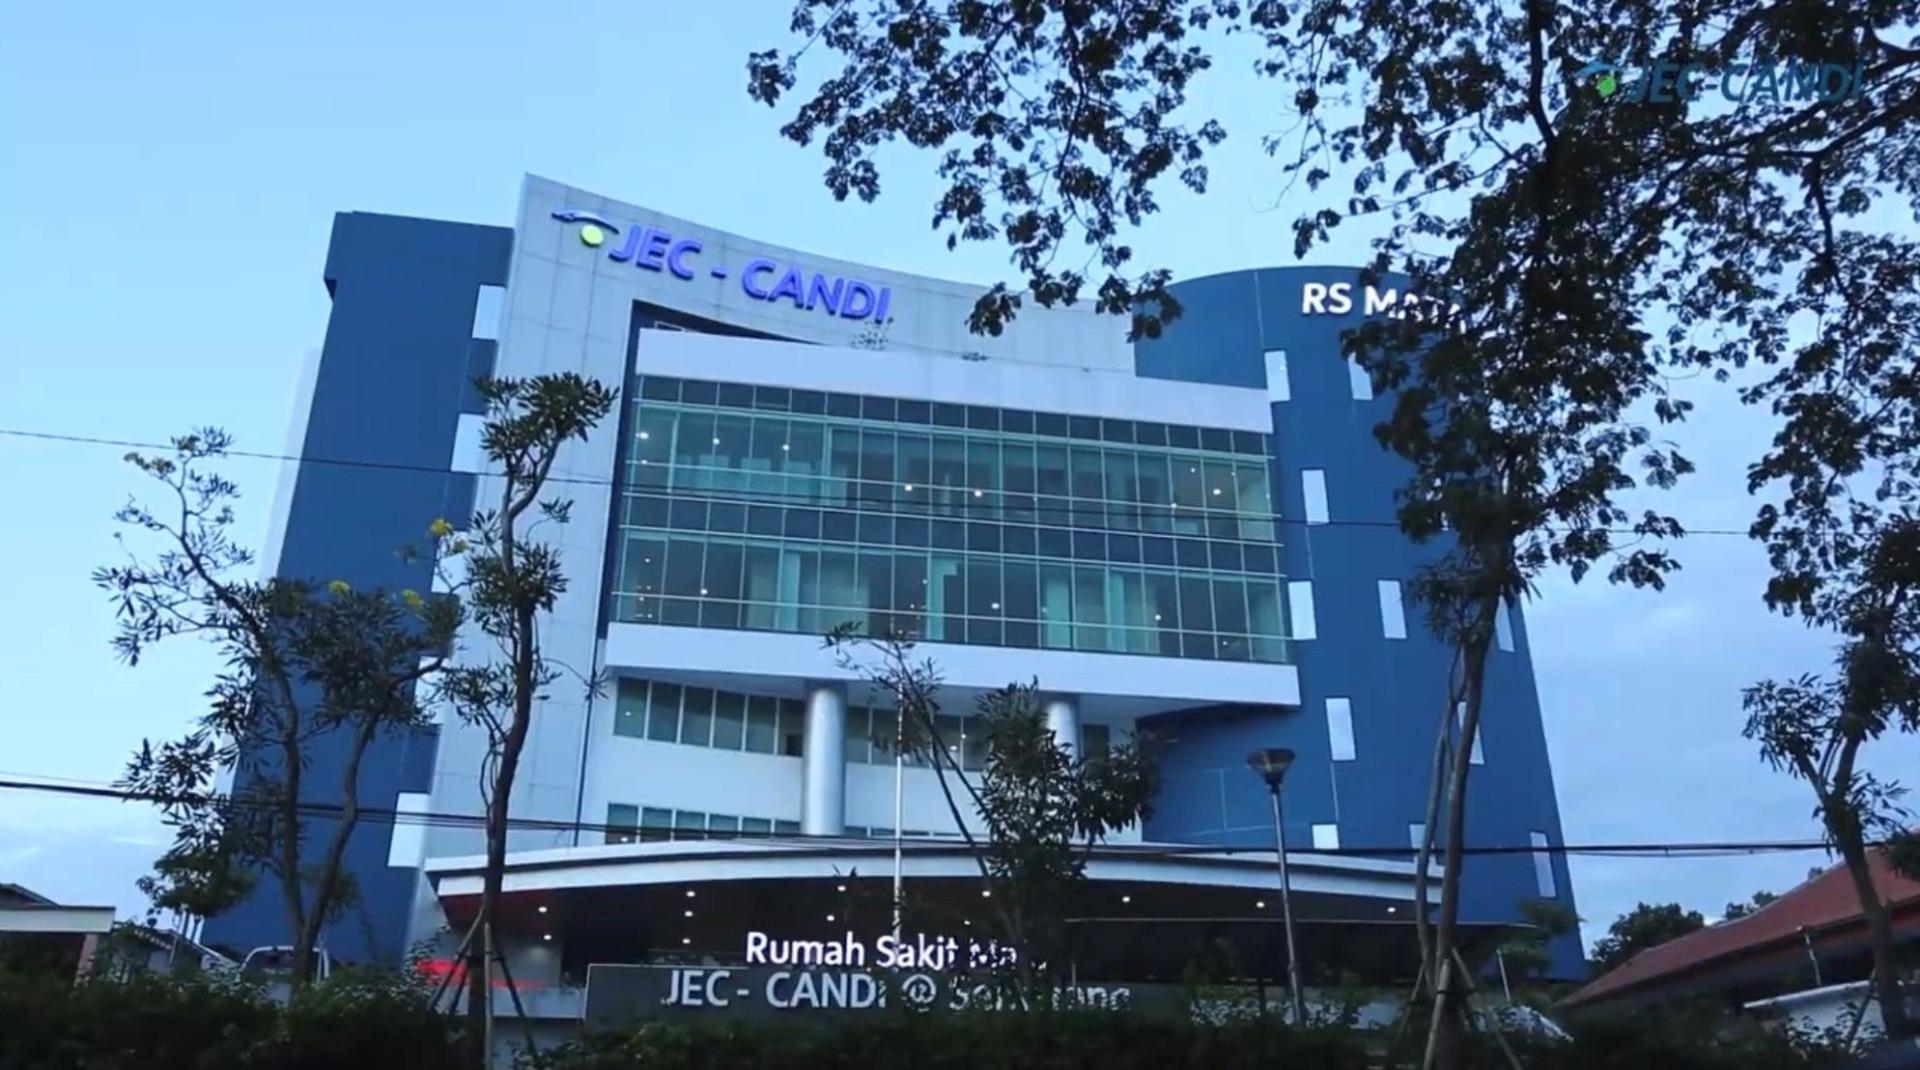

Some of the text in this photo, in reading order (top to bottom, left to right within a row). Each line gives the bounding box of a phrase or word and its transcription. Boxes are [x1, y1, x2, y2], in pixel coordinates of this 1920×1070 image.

[608, 224, 702, 281] JEC
[742, 259, 892, 324] CANDI
[1302, 282, 1353, 315] RS
[746, 931, 865, 967] Rumah
[876, 933, 958, 971] Sakit
